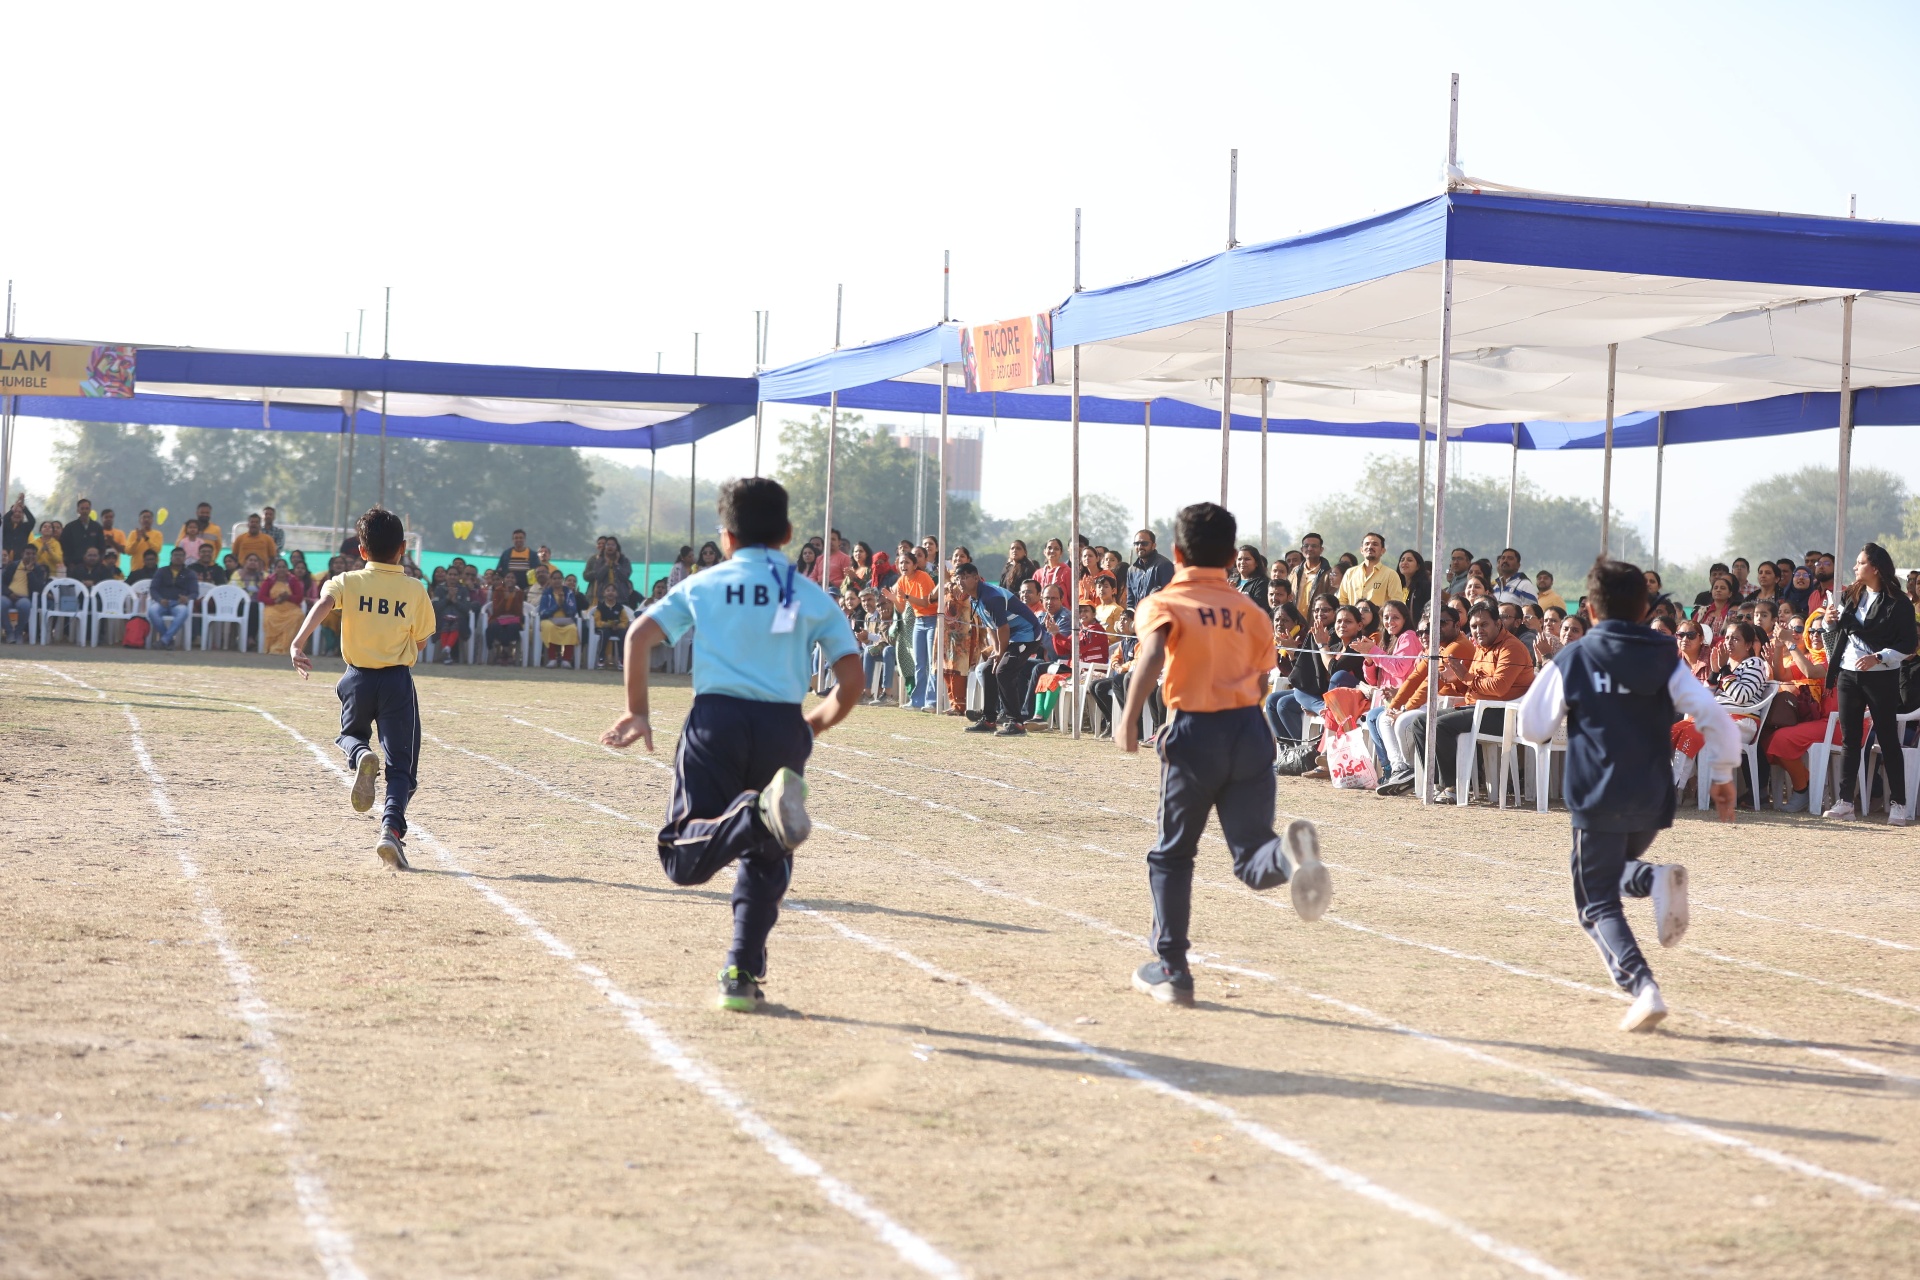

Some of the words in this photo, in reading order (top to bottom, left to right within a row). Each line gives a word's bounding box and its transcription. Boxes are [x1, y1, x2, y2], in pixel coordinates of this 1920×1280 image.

[984, 326, 1020, 358] TAGORE
[359, 595, 407, 618] HBK
[1198, 608, 1245, 633] HBK
